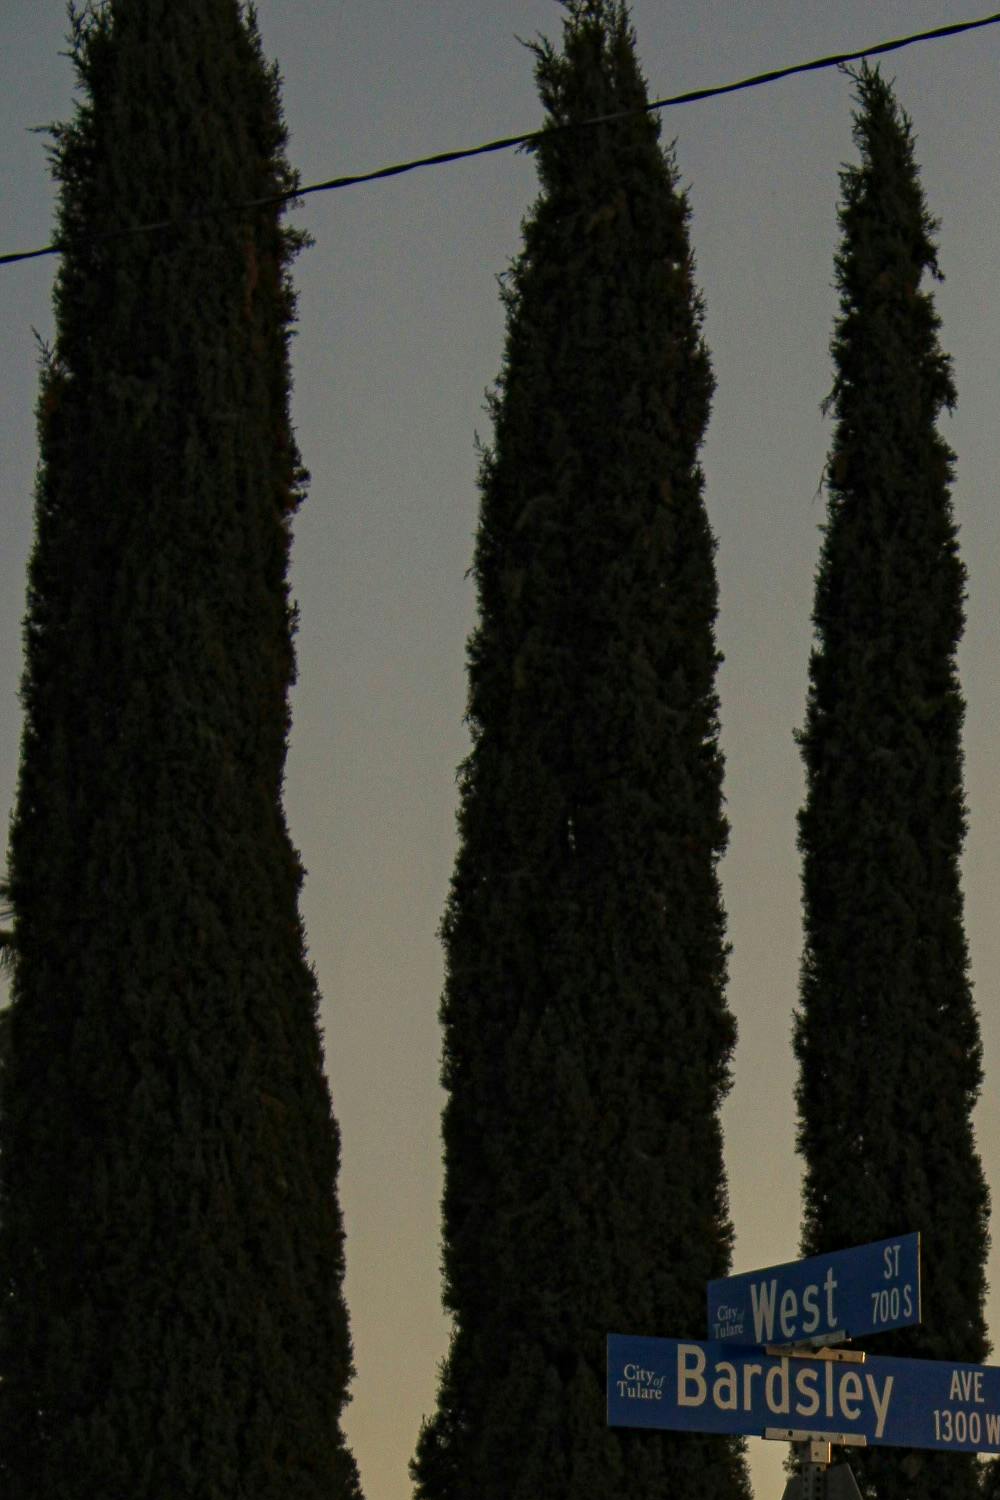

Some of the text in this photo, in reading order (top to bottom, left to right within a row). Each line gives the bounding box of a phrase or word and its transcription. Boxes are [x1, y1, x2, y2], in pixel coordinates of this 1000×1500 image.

[883, 1244, 901, 1280] ST
[717, 1305, 738, 1322] City
[751, 1267, 838, 1343] West
[713, 1321, 744, 1339] Tulare
[617, 1380, 662, 1400] Tulare
[623, 1364, 666, 1388] City of
[949, 1370, 985, 1403] AVE
[677, 1344, 894, 1438] Bardsley
